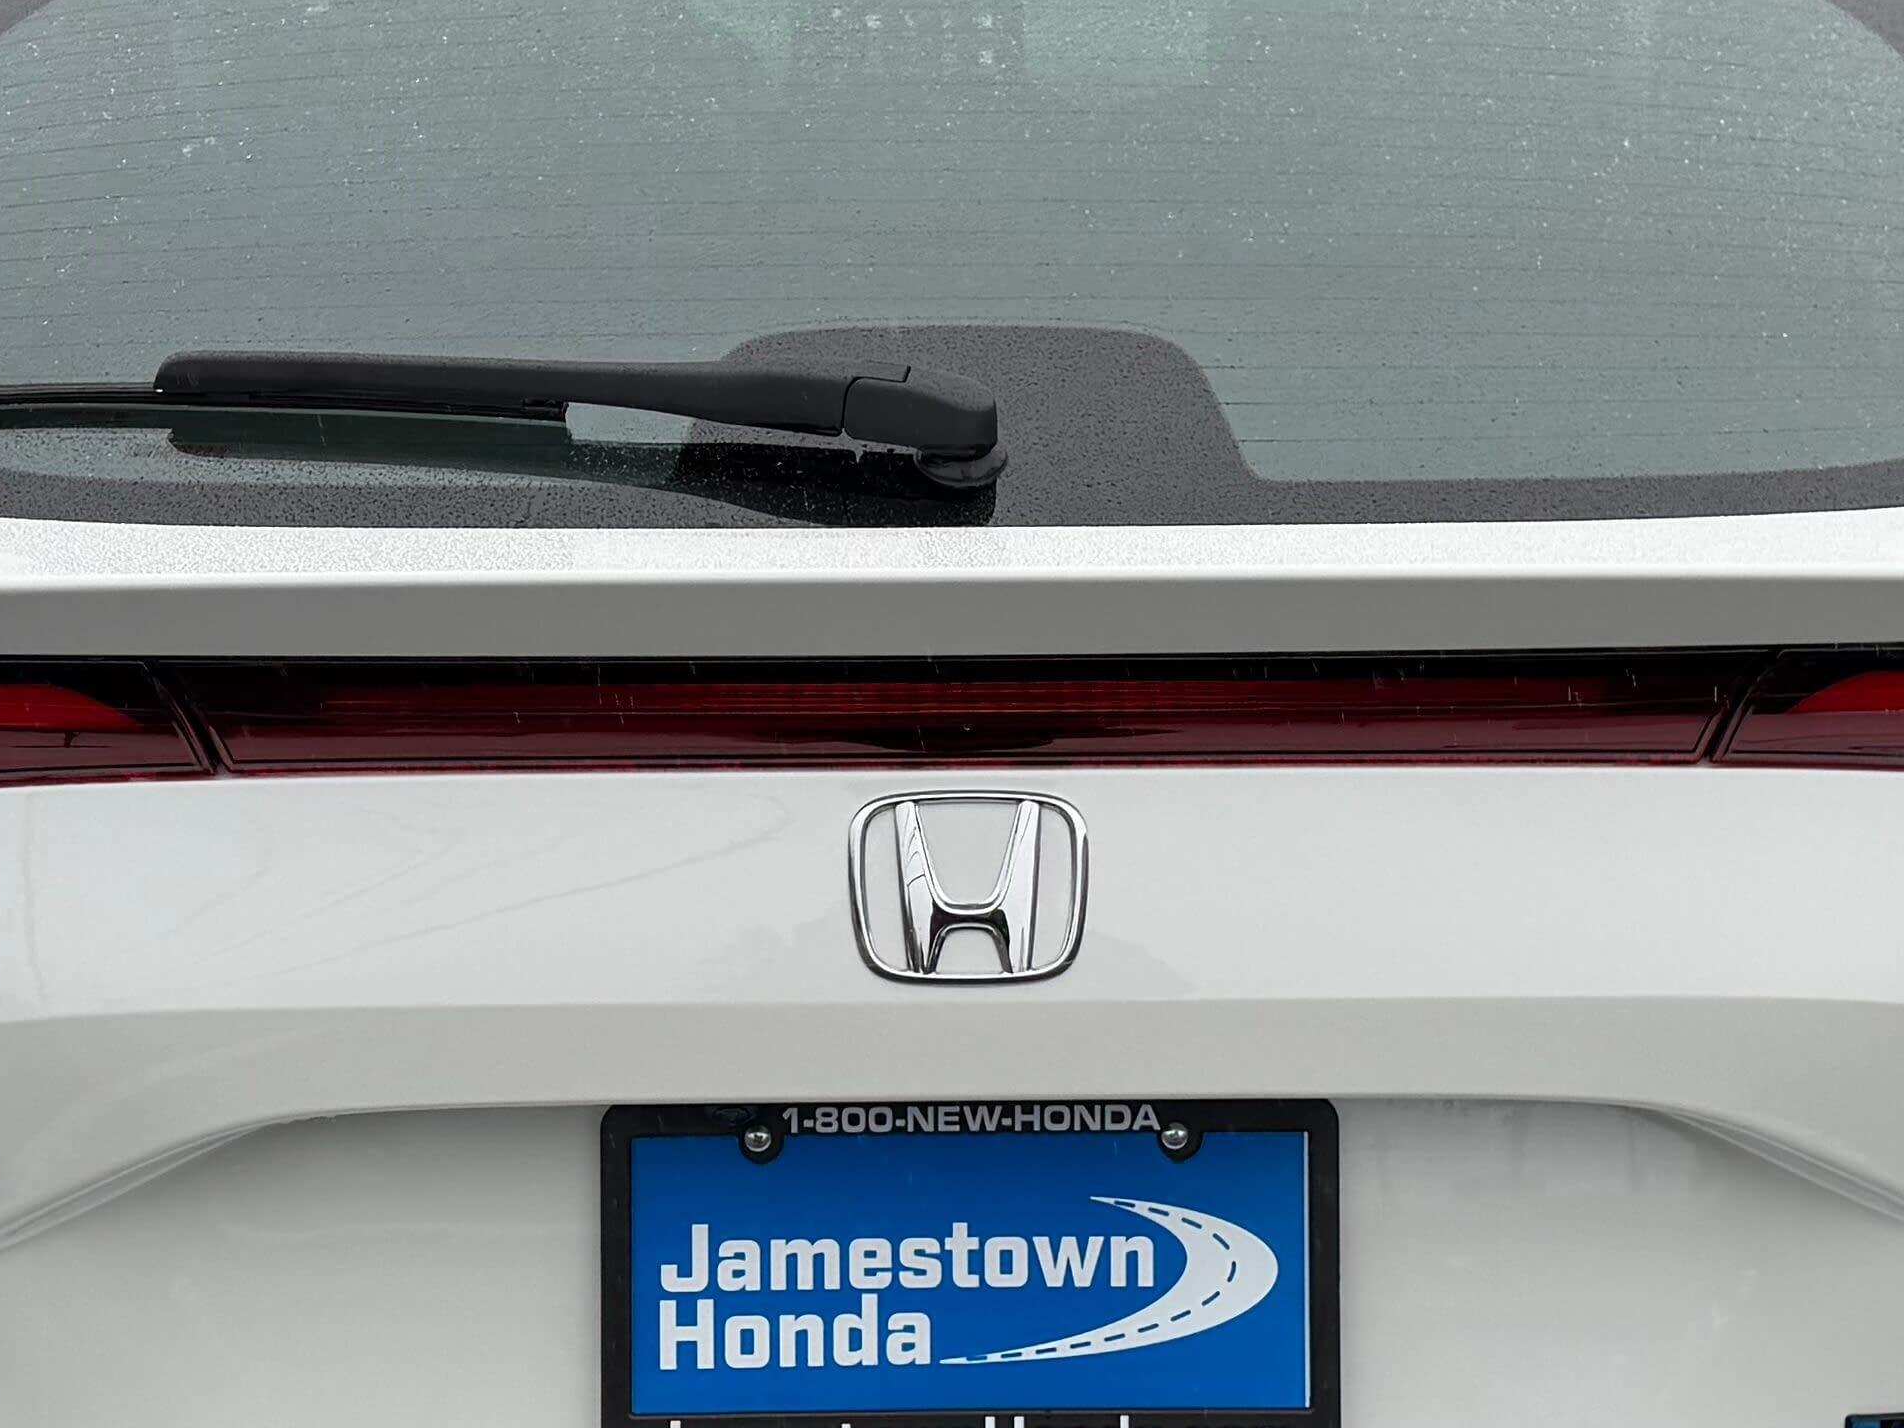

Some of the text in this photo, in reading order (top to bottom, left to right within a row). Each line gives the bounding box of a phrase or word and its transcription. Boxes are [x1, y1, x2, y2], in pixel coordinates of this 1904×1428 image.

[782, 1103, 1161, 1134] 1-800-NEW-HONDA
[659, 1222, 1156, 1293] Jamestown
[658, 1293, 933, 1371] Honda
